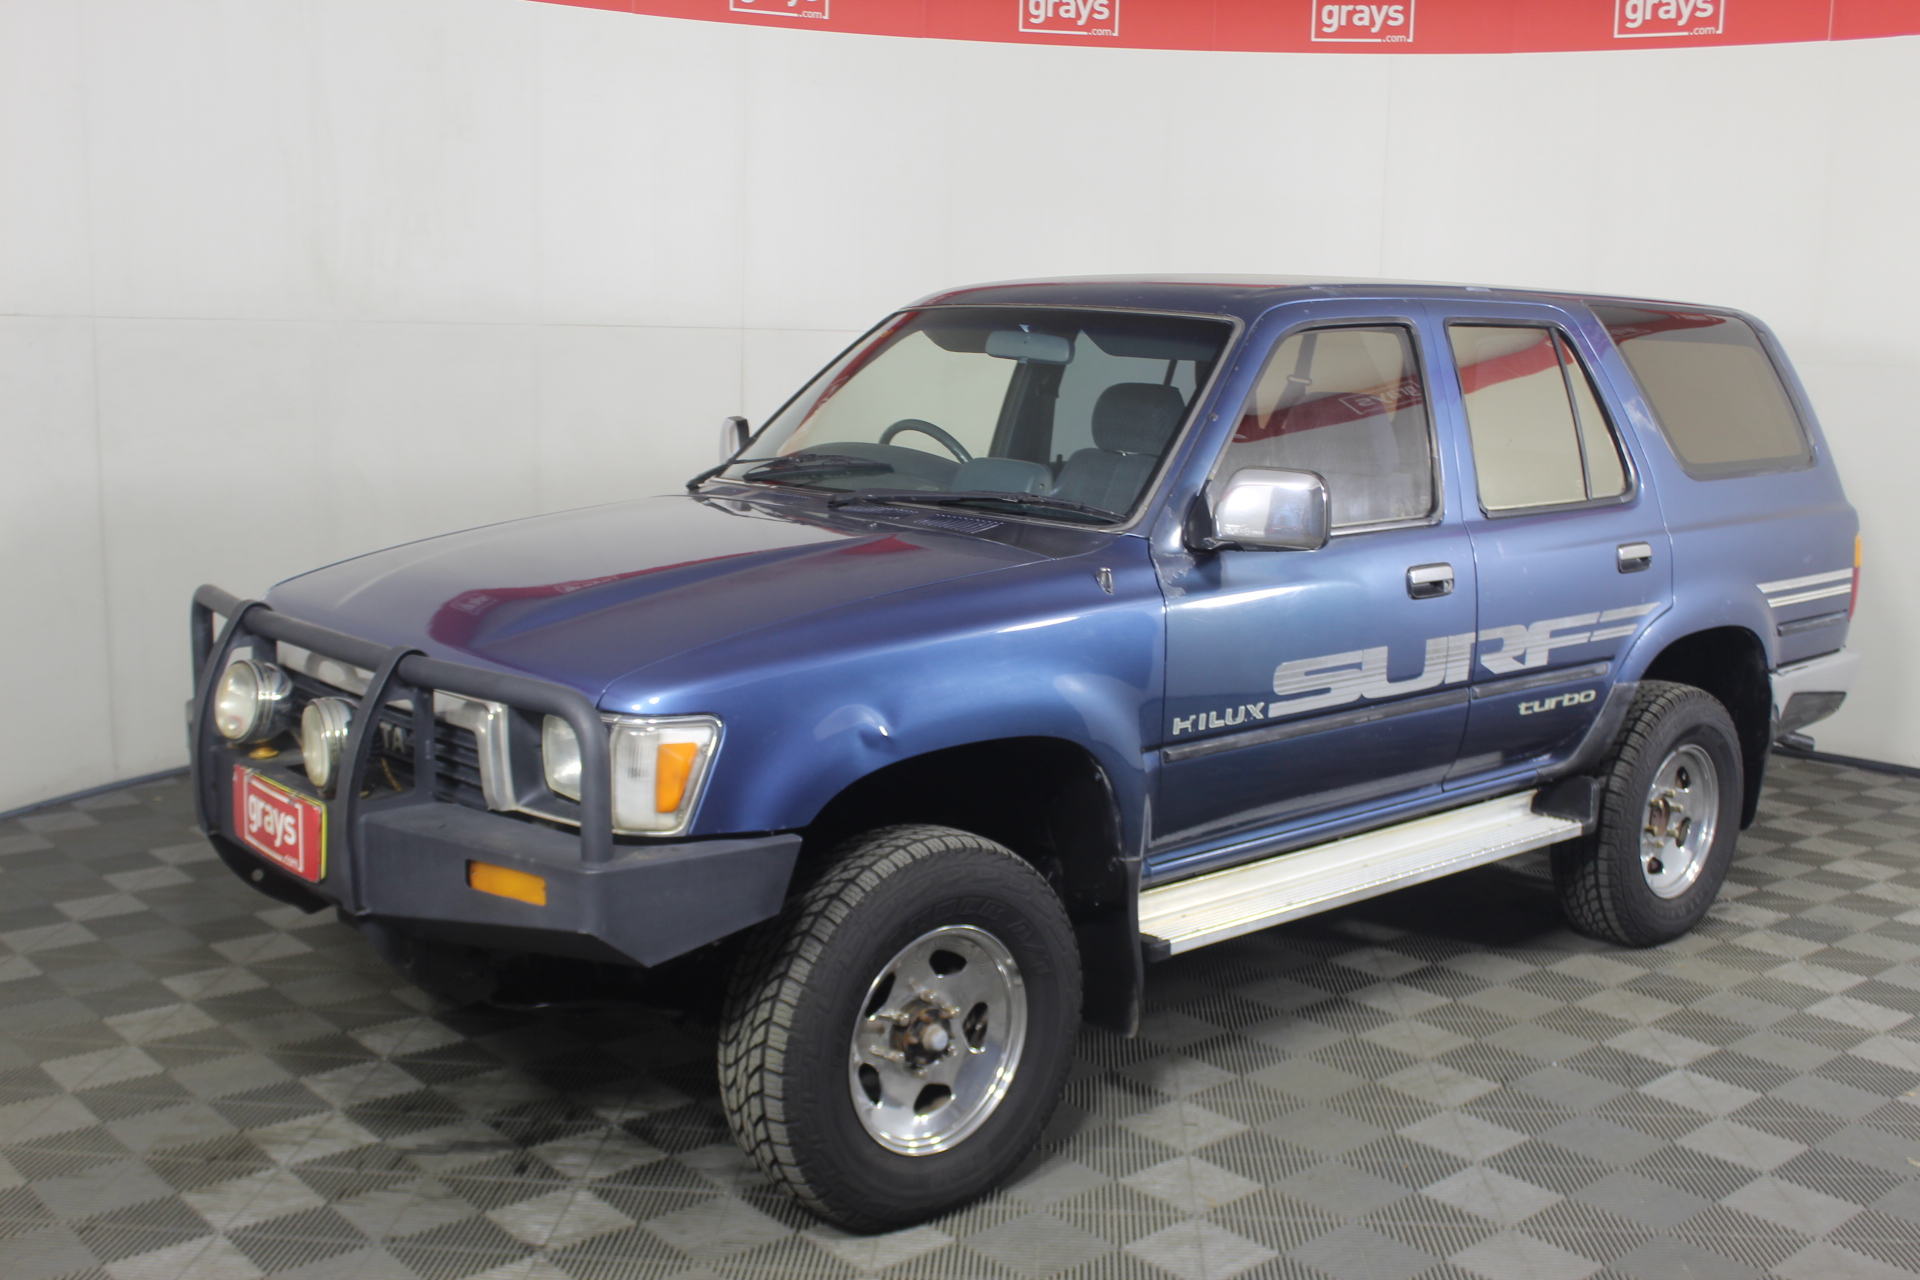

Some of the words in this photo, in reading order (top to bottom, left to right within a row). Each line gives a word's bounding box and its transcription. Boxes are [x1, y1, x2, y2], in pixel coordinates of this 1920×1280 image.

[798, 10, 823, 19] .com
[1029, 0, 1110, 25] grays
[1321, 5, 1405, 33] grays
[1625, 0, 1714, 28] grays
[1088, 28, 1113, 36] .com
[1382, 35, 1407, 43] .com
[1689, 27, 1716, 36] .com
[1268, 603, 1661, 718] SURF
[1518, 689, 1597, 716] turbo
[1172, 701, 1265, 736] HILUX
[248, 794, 297, 848] grays
